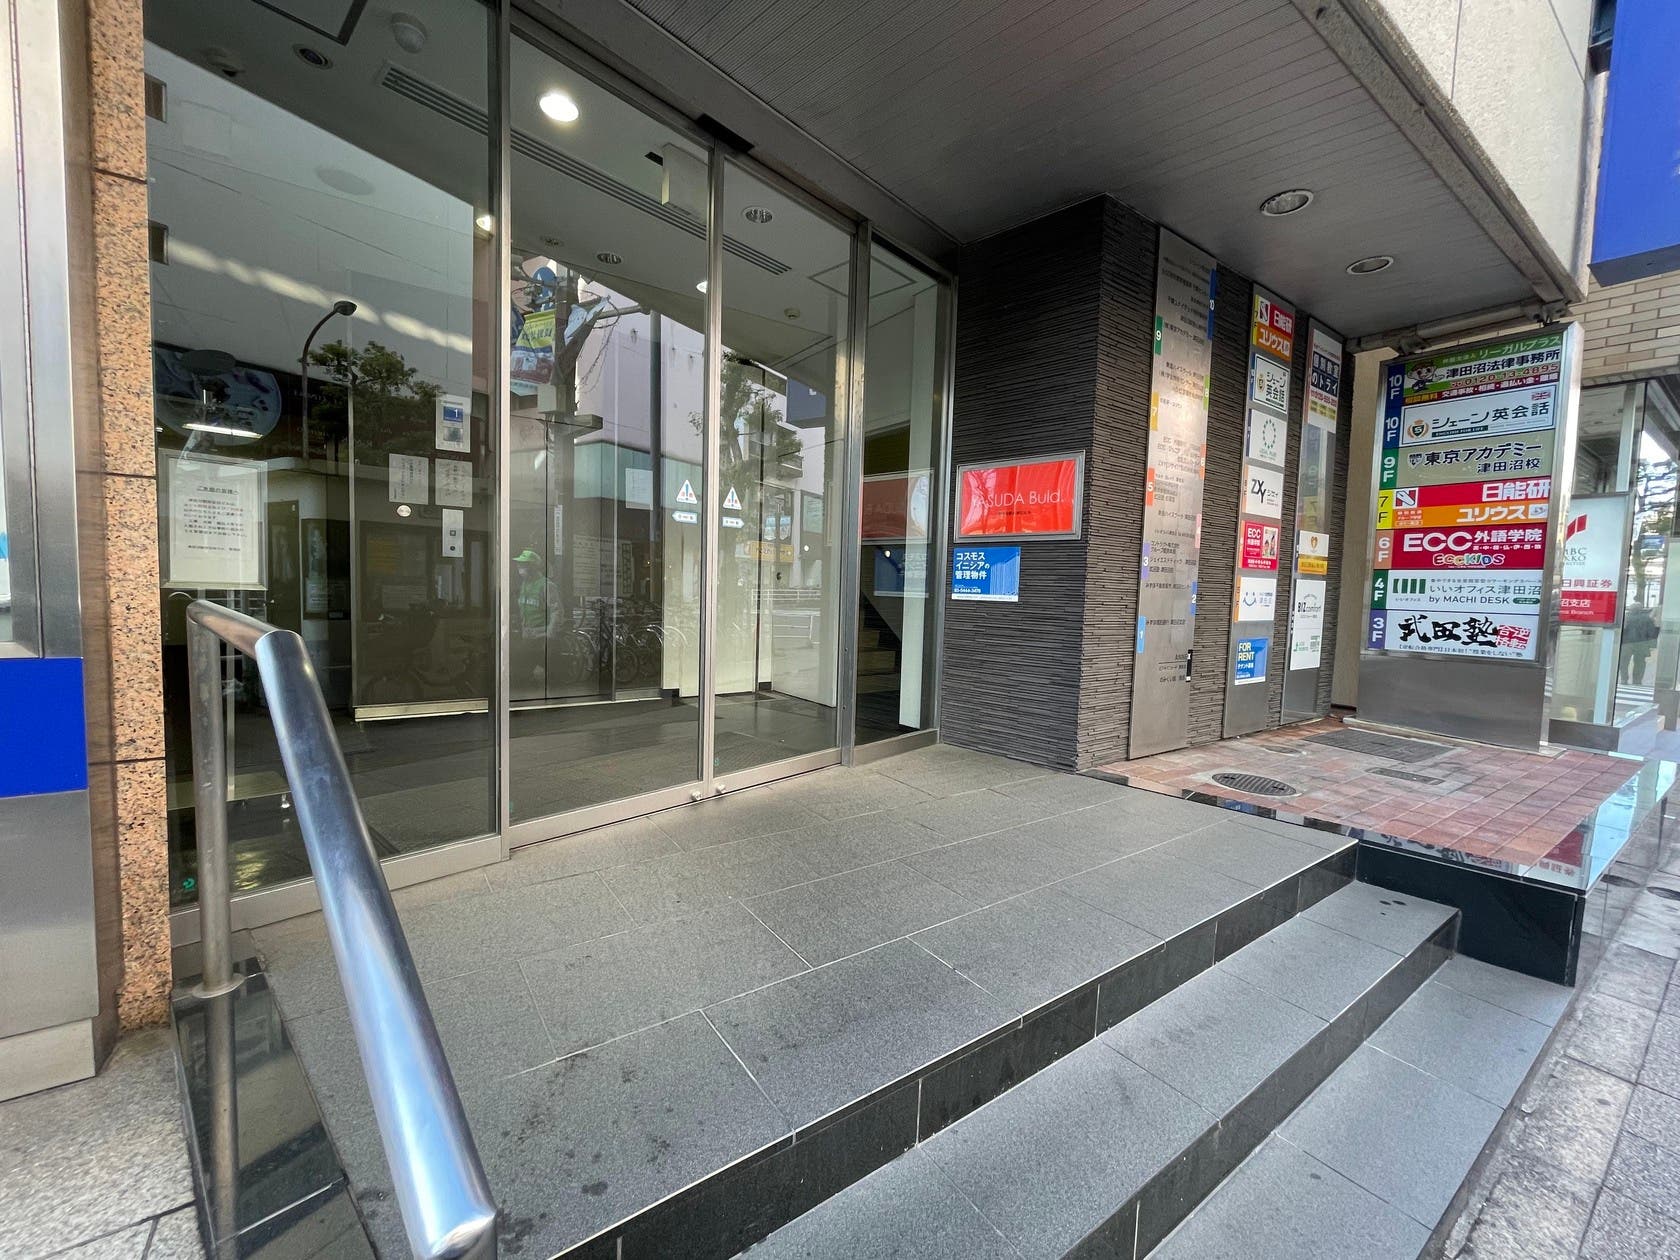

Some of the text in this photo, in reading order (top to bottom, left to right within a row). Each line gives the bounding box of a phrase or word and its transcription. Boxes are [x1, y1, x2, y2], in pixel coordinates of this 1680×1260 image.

[1156, 331, 1162, 341] 9
[1479, 337, 1560, 358] リーガルプラス
[1446, 349, 1560, 379] 津田沼法律事務所
[1389, 374, 1402, 387] 10
[1390, 388, 1400, 399] F
[1431, 403, 1549, 429] シェーン英会話
[1385, 416, 1399, 429] 10
[1387, 431, 1397, 442] F
[1424, 442, 1542, 466] 東京アカデミー
[1383, 456, 1396, 469] 9
[1477, 458, 1541, 473] 津田沼校
[1383, 470, 1394, 482] F
[1148, 482, 1154, 492] 5
[1482, 479, 1550, 502] 日能研
[1379, 495, 1389, 508] 7
[1378, 512, 1388, 524] F
[1456, 504, 1526, 523] ユリウス
[1248, 528, 1261, 538] ECC
[1378, 537, 1390, 548] 6
[1403, 529, 1543, 552] ECC 外語学院
[956, 552, 985, 561] コスモス
[1143, 556, 1149, 566] 3
[1378, 551, 1389, 562] F
[956, 561, 990, 570] イニシアの
[955, 570, 987, 580] 管理物件
[1374, 577, 1385, 588] 4
[1374, 590, 1384, 601] F
[1430, 584, 1541, 596] いいオフィス津田沼
[1191, 594, 1197, 604] 2
[1428, 596, 1440, 604] by
[1443, 596, 1477, 604] MACHI
[1480, 596, 1510, 604] DESK
[1373, 617, 1384, 629] 3
[1372, 631, 1383, 642] F
[1397, 614, 1499, 648] 武田塾
[1238, 642, 1251, 652] FOR
[1238, 652, 1254, 661] RENT
